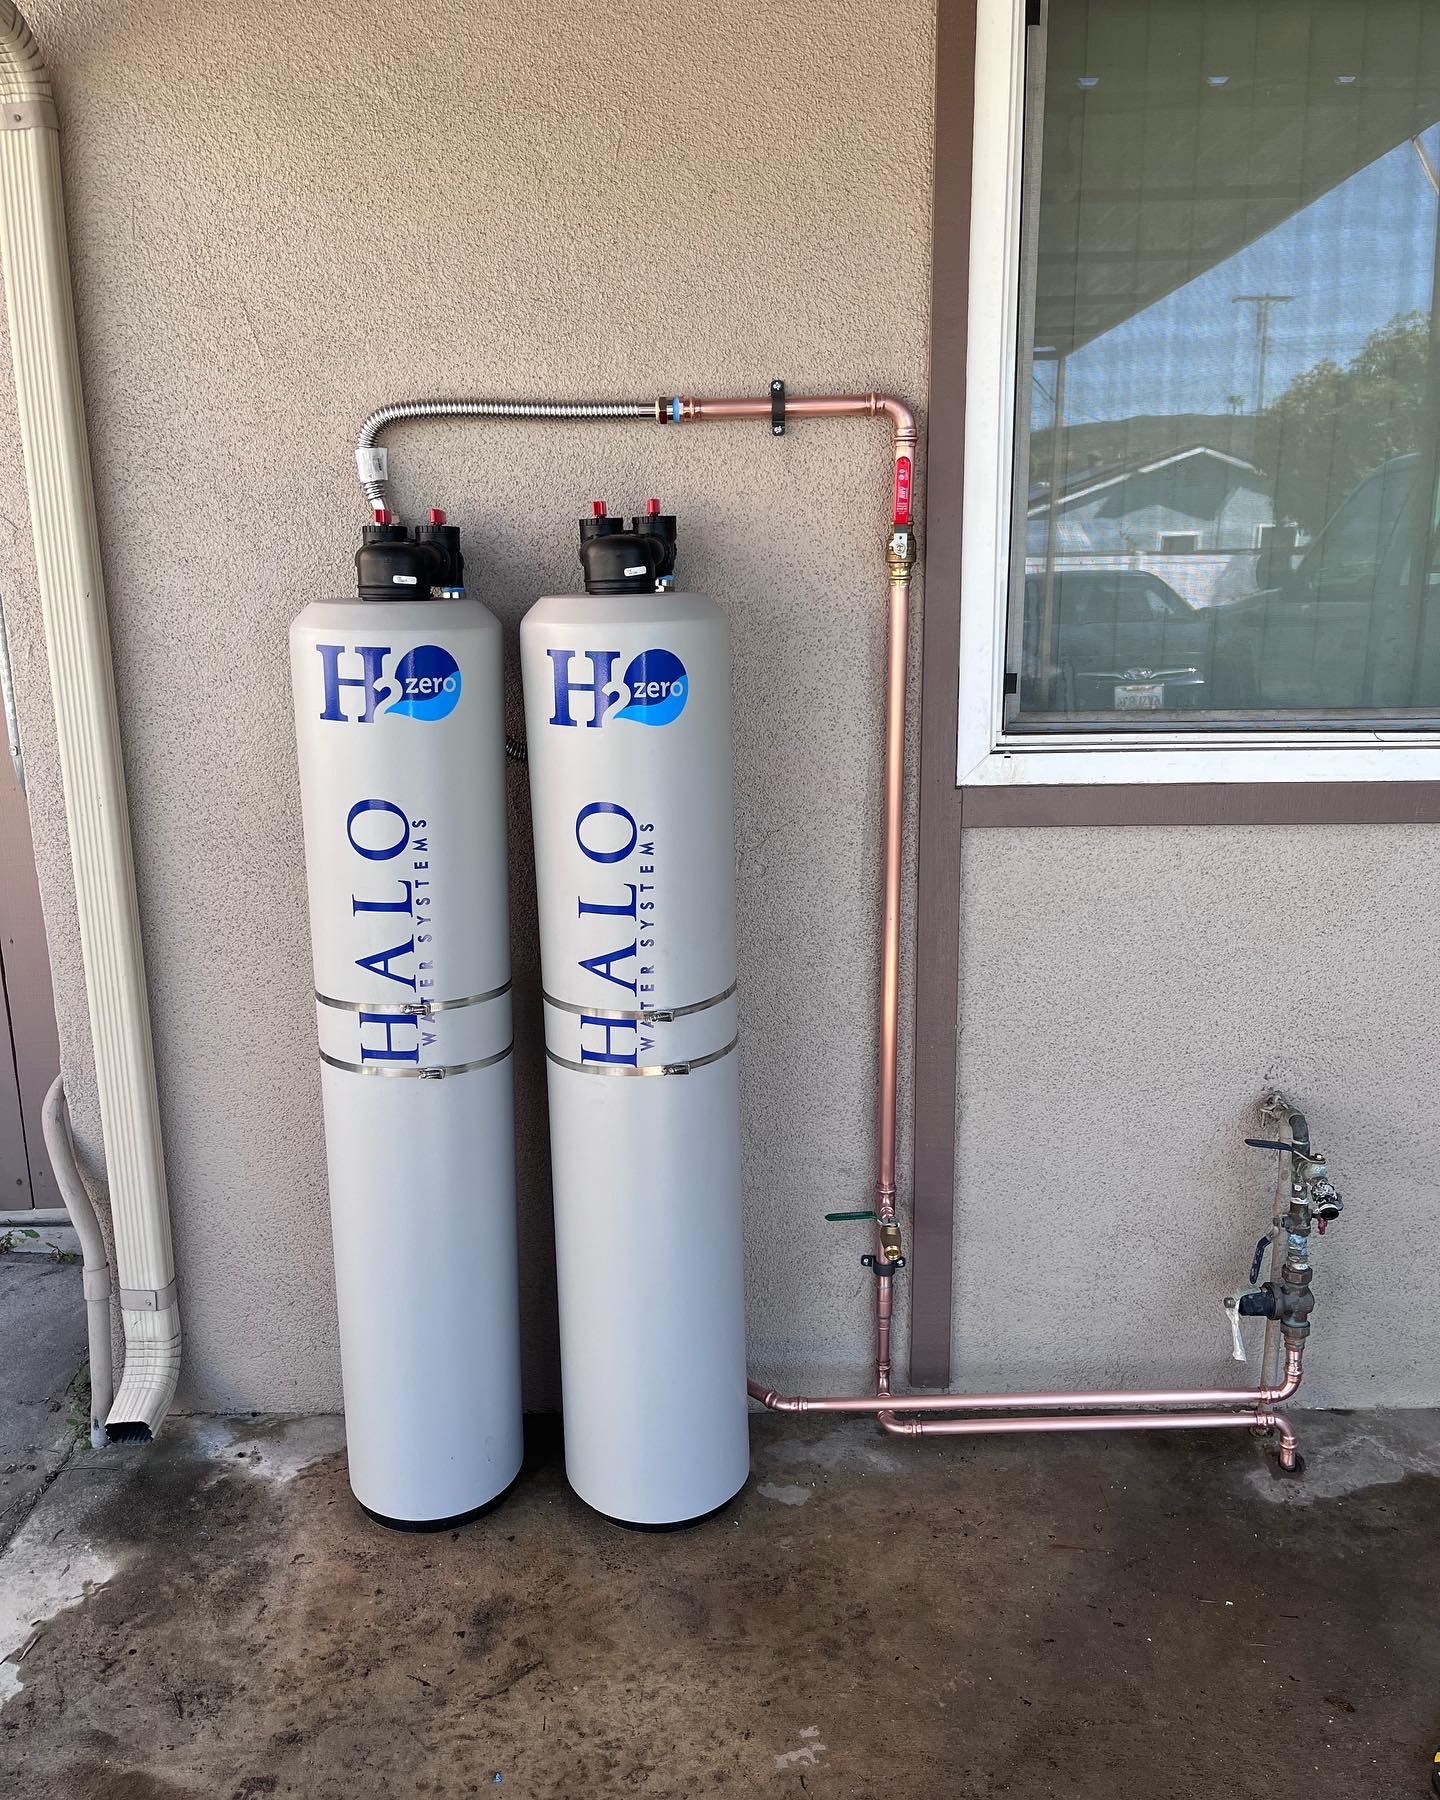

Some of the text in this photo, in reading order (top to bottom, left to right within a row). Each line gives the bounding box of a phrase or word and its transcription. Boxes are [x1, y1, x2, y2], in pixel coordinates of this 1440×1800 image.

[405, 676, 457, 694] zero
[633, 680, 684, 698] zero
[346, 798, 420, 1064] HALO
[412, 819, 432, 942] SYSTEMS
[575, 801, 638, 1068] HALO
[639, 823, 655, 947] SYSTEMS
